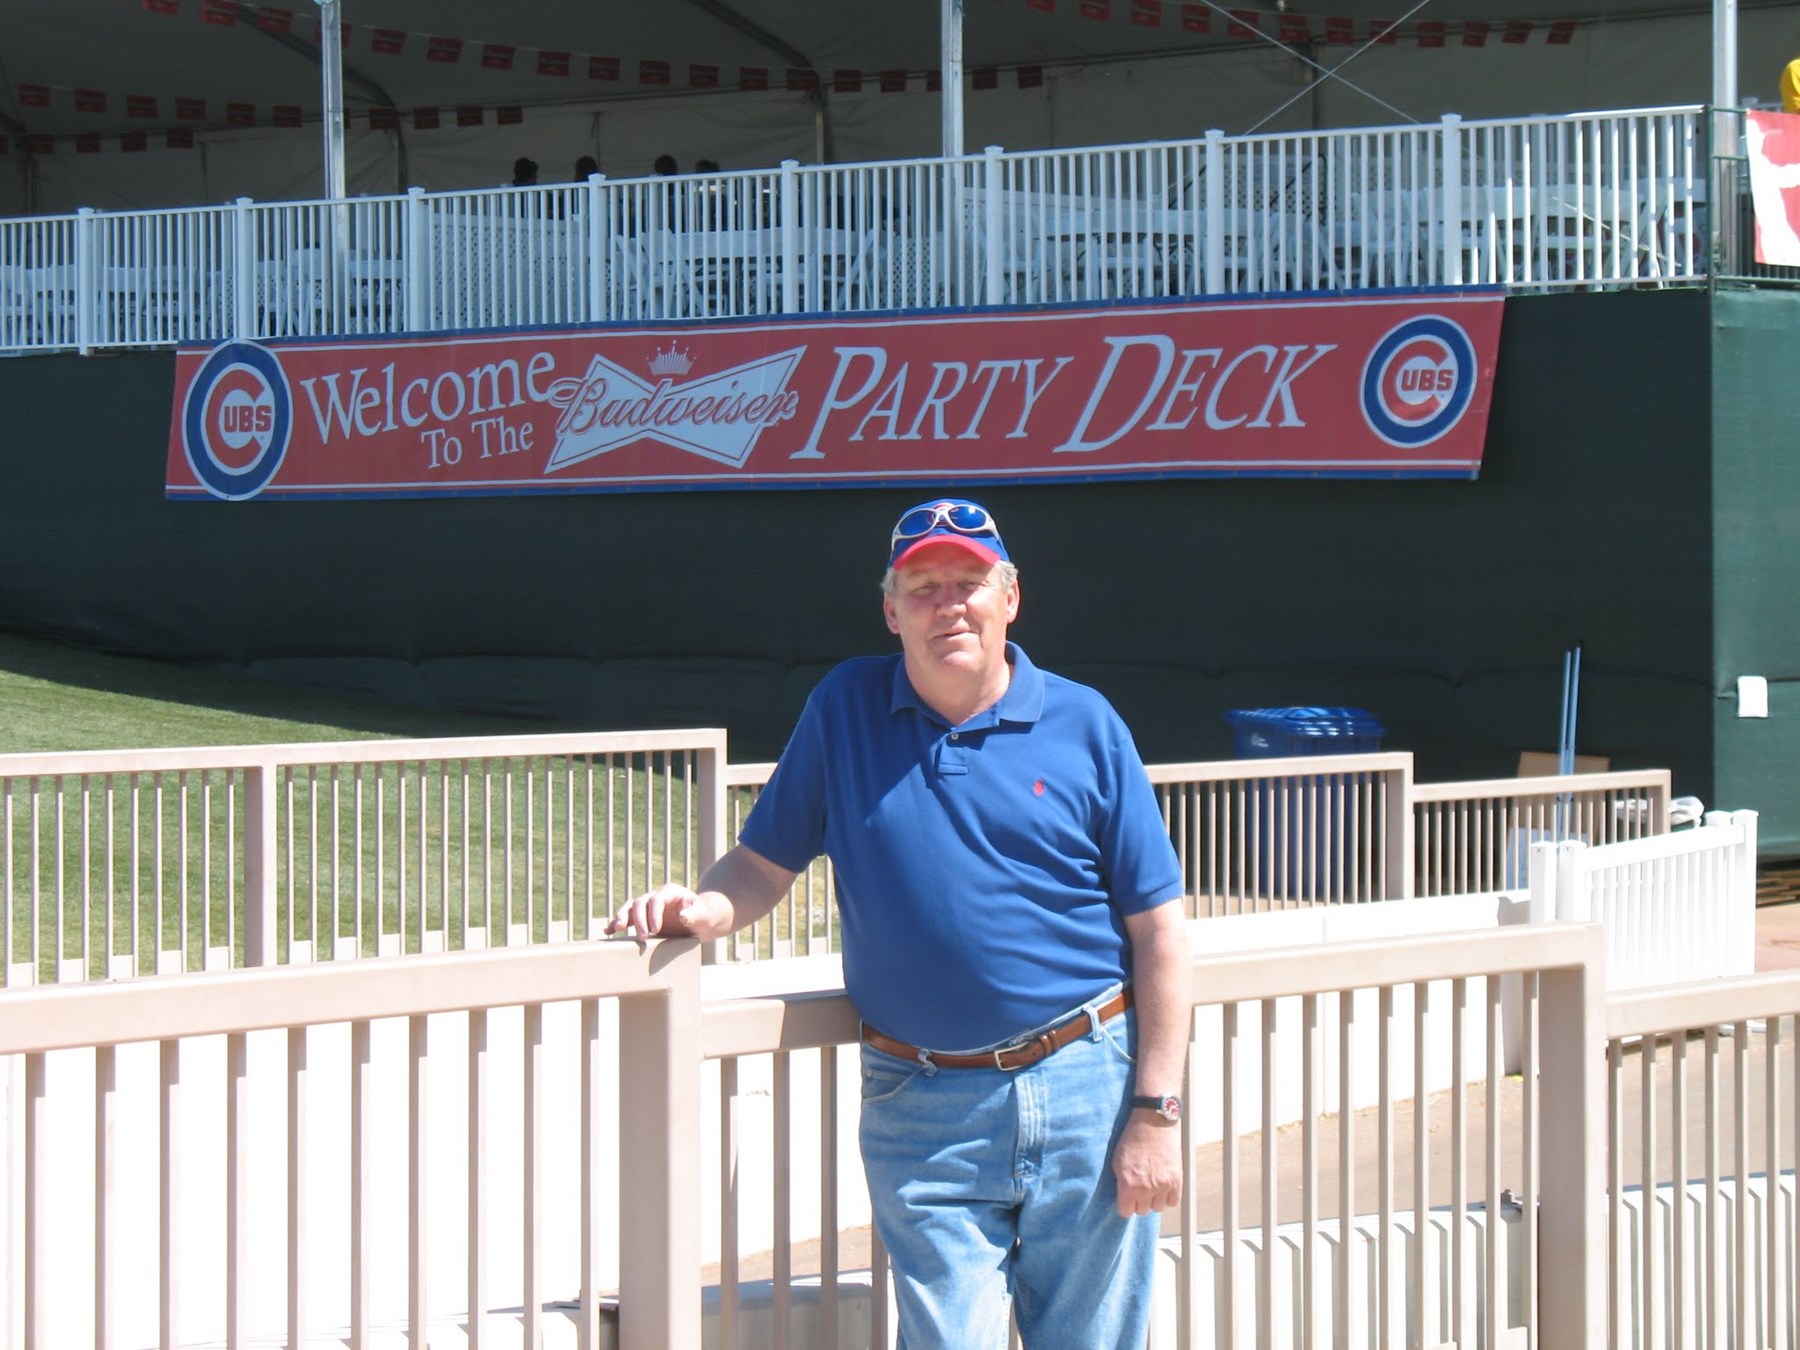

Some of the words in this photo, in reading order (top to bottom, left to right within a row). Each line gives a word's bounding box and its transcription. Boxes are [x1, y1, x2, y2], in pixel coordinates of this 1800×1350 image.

[300, 351, 556, 444] Welcome
[549, 377, 799, 437] Budweiser
[789, 346, 1075, 459] PARTY
[1052, 334, 1338, 453] DECK
[420, 428, 463, 469] To
[471, 415, 534, 459] The
